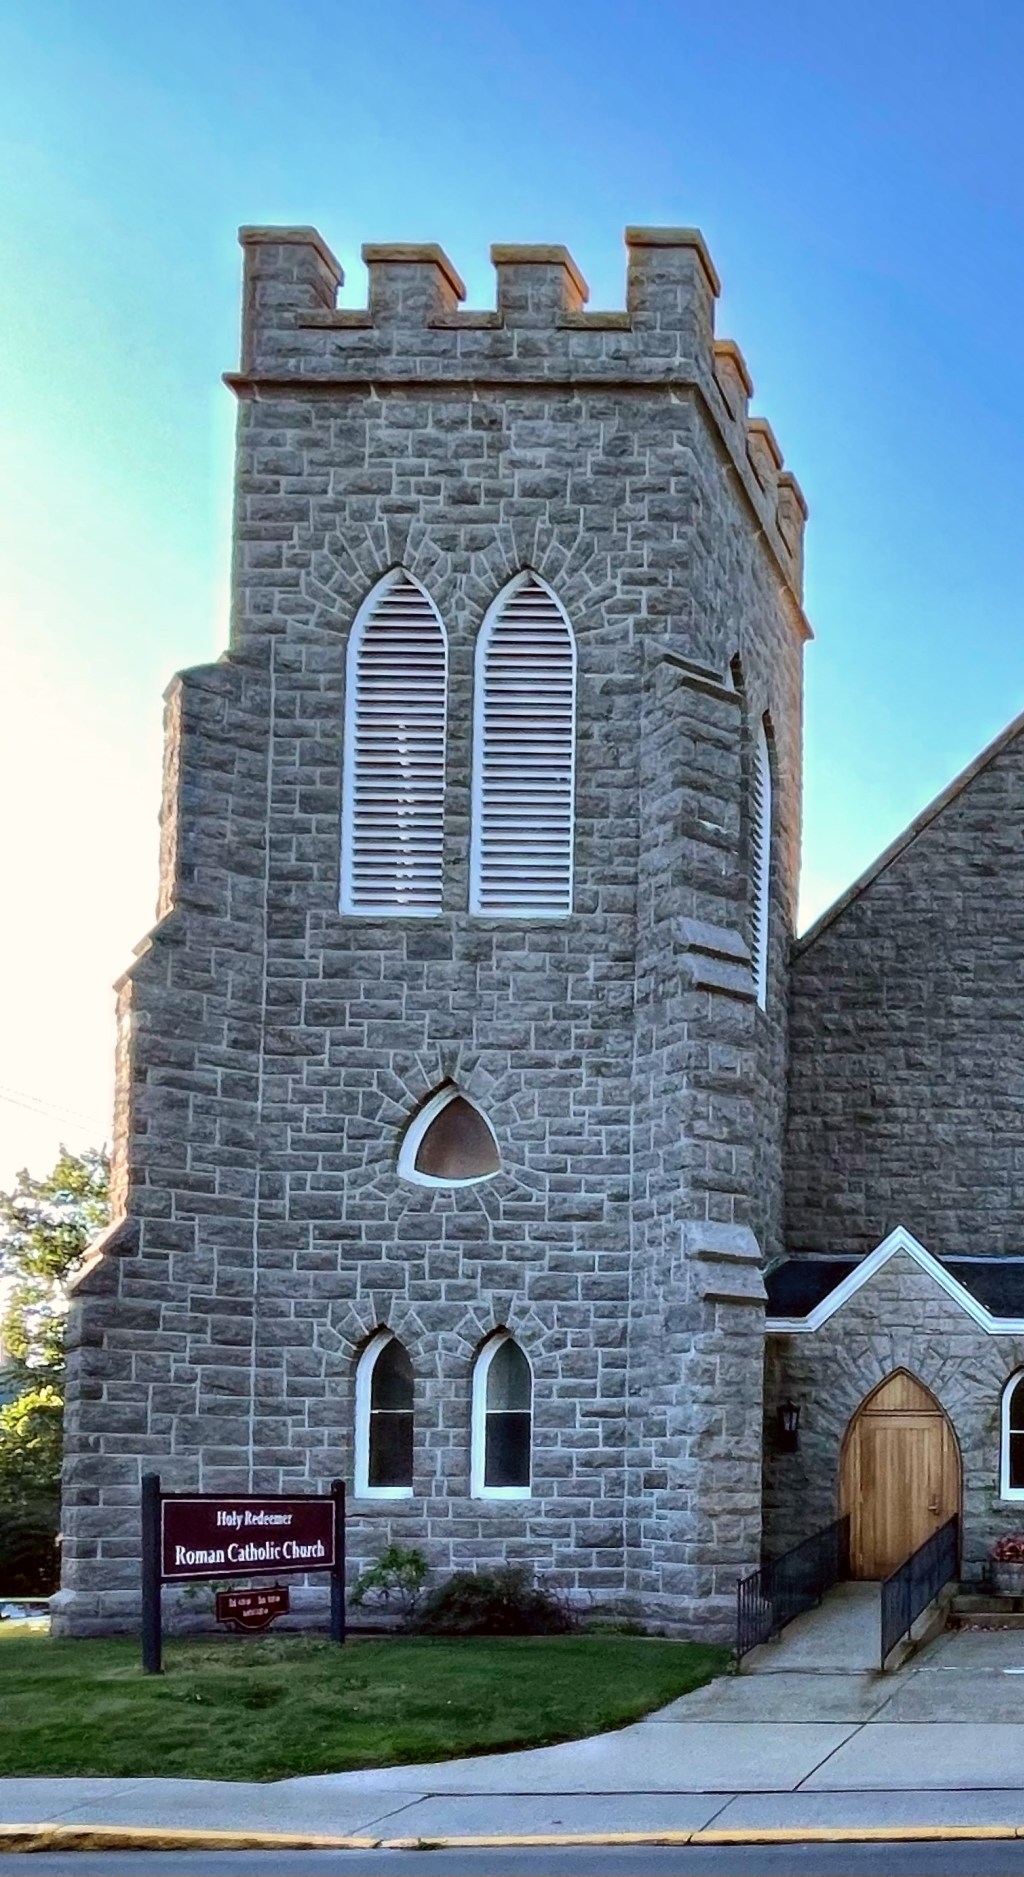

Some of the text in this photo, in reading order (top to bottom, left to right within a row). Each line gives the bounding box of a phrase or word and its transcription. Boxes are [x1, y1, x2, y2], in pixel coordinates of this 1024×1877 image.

[217, 1510, 293, 1530] Holy Redeemer
[175, 1539, 325, 1565] Roman Catholic Church
